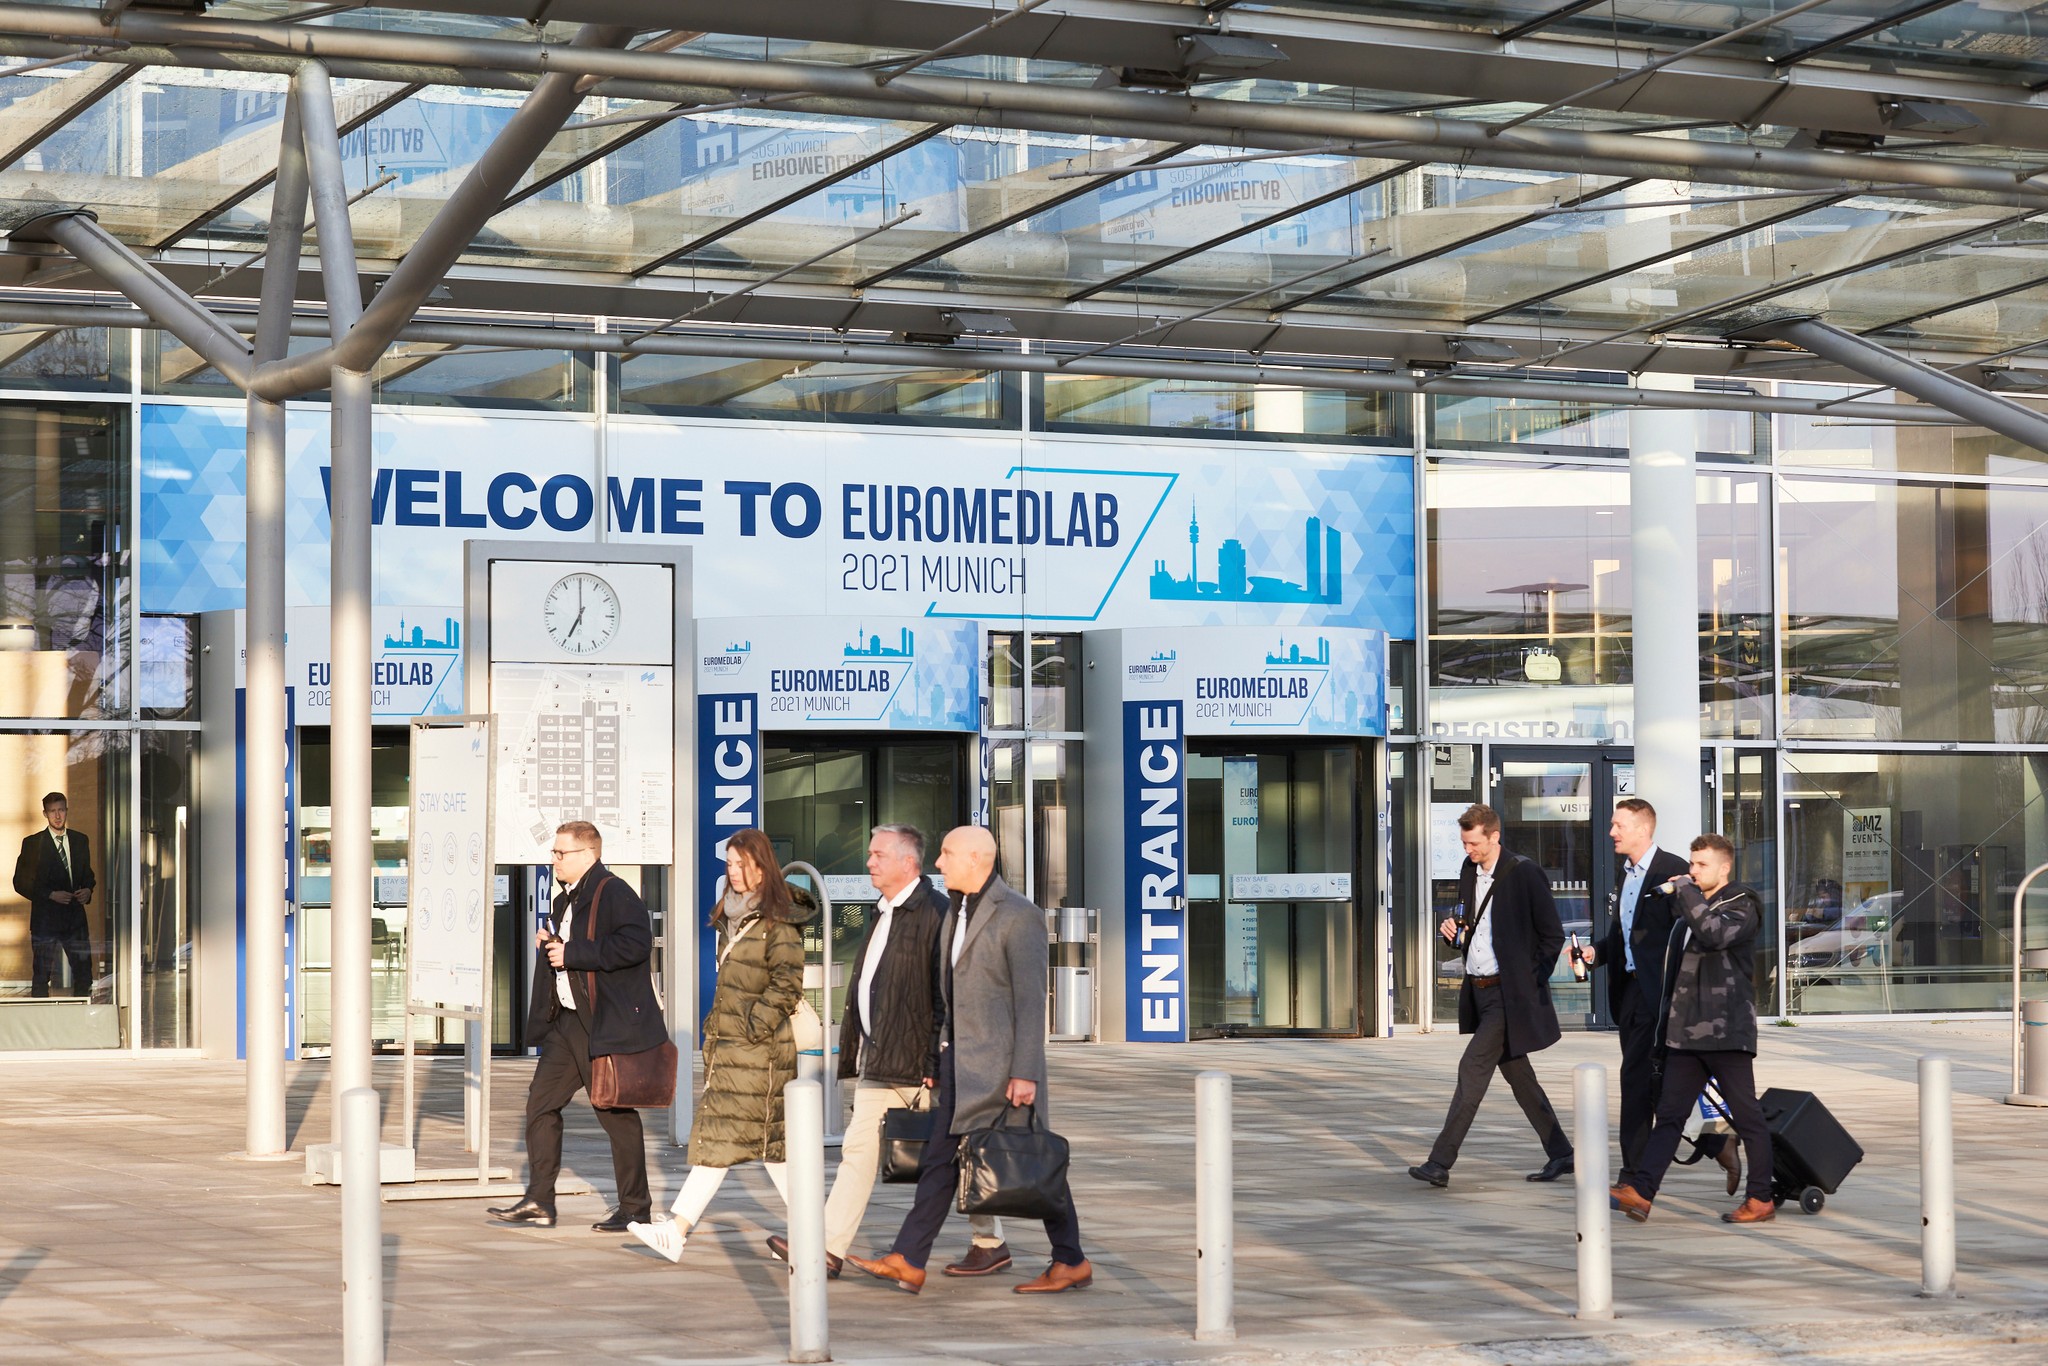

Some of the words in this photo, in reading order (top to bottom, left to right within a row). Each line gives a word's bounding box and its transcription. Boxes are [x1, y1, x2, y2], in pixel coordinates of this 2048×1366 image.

[725, 481, 821, 538] TO
[843, 484, 1118, 547] EUROMEDLAB
[843, 554, 908, 591] 2021
[923, 557, 1025, 594] MUNICH
[704, 655, 742, 666] EUROMEDLAB
[1129, 664, 1167, 674] EUROMEDLAB
[309, 663, 432, 686] EUEDLAB
[772, 669, 890, 692] EUROMEDLAB
[1197, 677, 1308, 699] EUROMEDLAB
[771, 696, 800, 711] 2021
[805, 696, 850, 712] MUNICH
[1197, 703, 1224, 718] 2021
[1229, 702, 1272, 718] MUNICH
[419, 792, 441, 812] STAY
[443, 792, 467, 812] SAFE
[1852, 833, 1882, 843] EVENTS
[1140, 706, 1180, 1032] ENTRANCE
